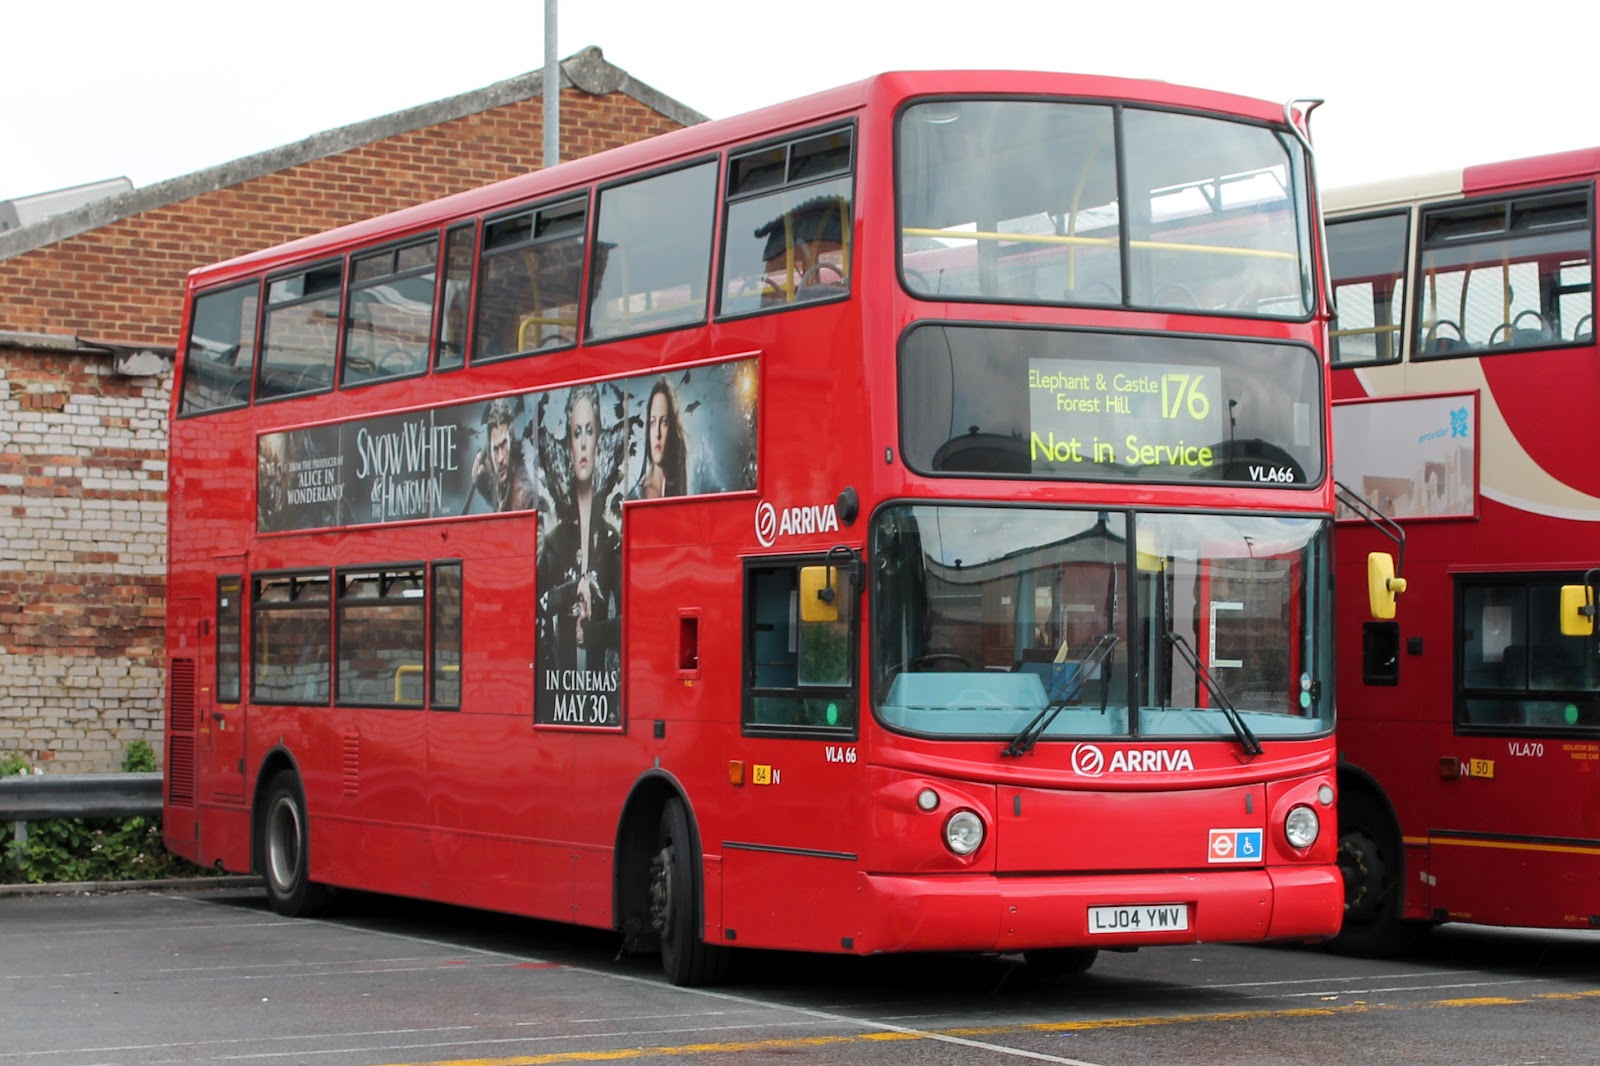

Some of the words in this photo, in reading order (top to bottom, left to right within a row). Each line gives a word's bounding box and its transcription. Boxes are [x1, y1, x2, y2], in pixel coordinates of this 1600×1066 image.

[1029, 369, 1090, 393] Elephant
[1095, 373, 1107, 391] &
[1113, 373, 1159, 393] Castle
[1057, 393, 1101, 413] Forest
[1105, 395, 1131, 414] Hill
[1161, 373, 1210, 420] 176
[357, 428, 404, 479] SNOW
[403, 419, 458, 471] WHITE
[1030, 431, 1082, 463] Not
[1093, 436, 1114, 464] in
[1125, 434, 1214, 467] Service
[324, 468, 335, 484] IN
[1249, 465, 1294, 483] VLA66
[381, 472, 442, 523] HUNTSMAN
[779, 504, 839, 535] ARRIVA
[545, 670, 560, 691] IN
[562, 669, 617, 692] CINEMAS
[552, 694, 587, 723] MAY
[589, 694, 609, 724] 30
[825, 746, 844, 762] VLA
[845, 747, 857, 763] 66
[1108, 749, 1194, 773] ARRIVA
[1508, 742, 1544, 757] VLA70
[756, 767, 766, 782] 84
[772, 770, 781, 784] N
[1460, 763, 1469, 776] N
[1476, 761, 1488, 775] 50
[1095, 910, 1141, 929] LJ04
[1147, 908, 1180, 926] YWV
